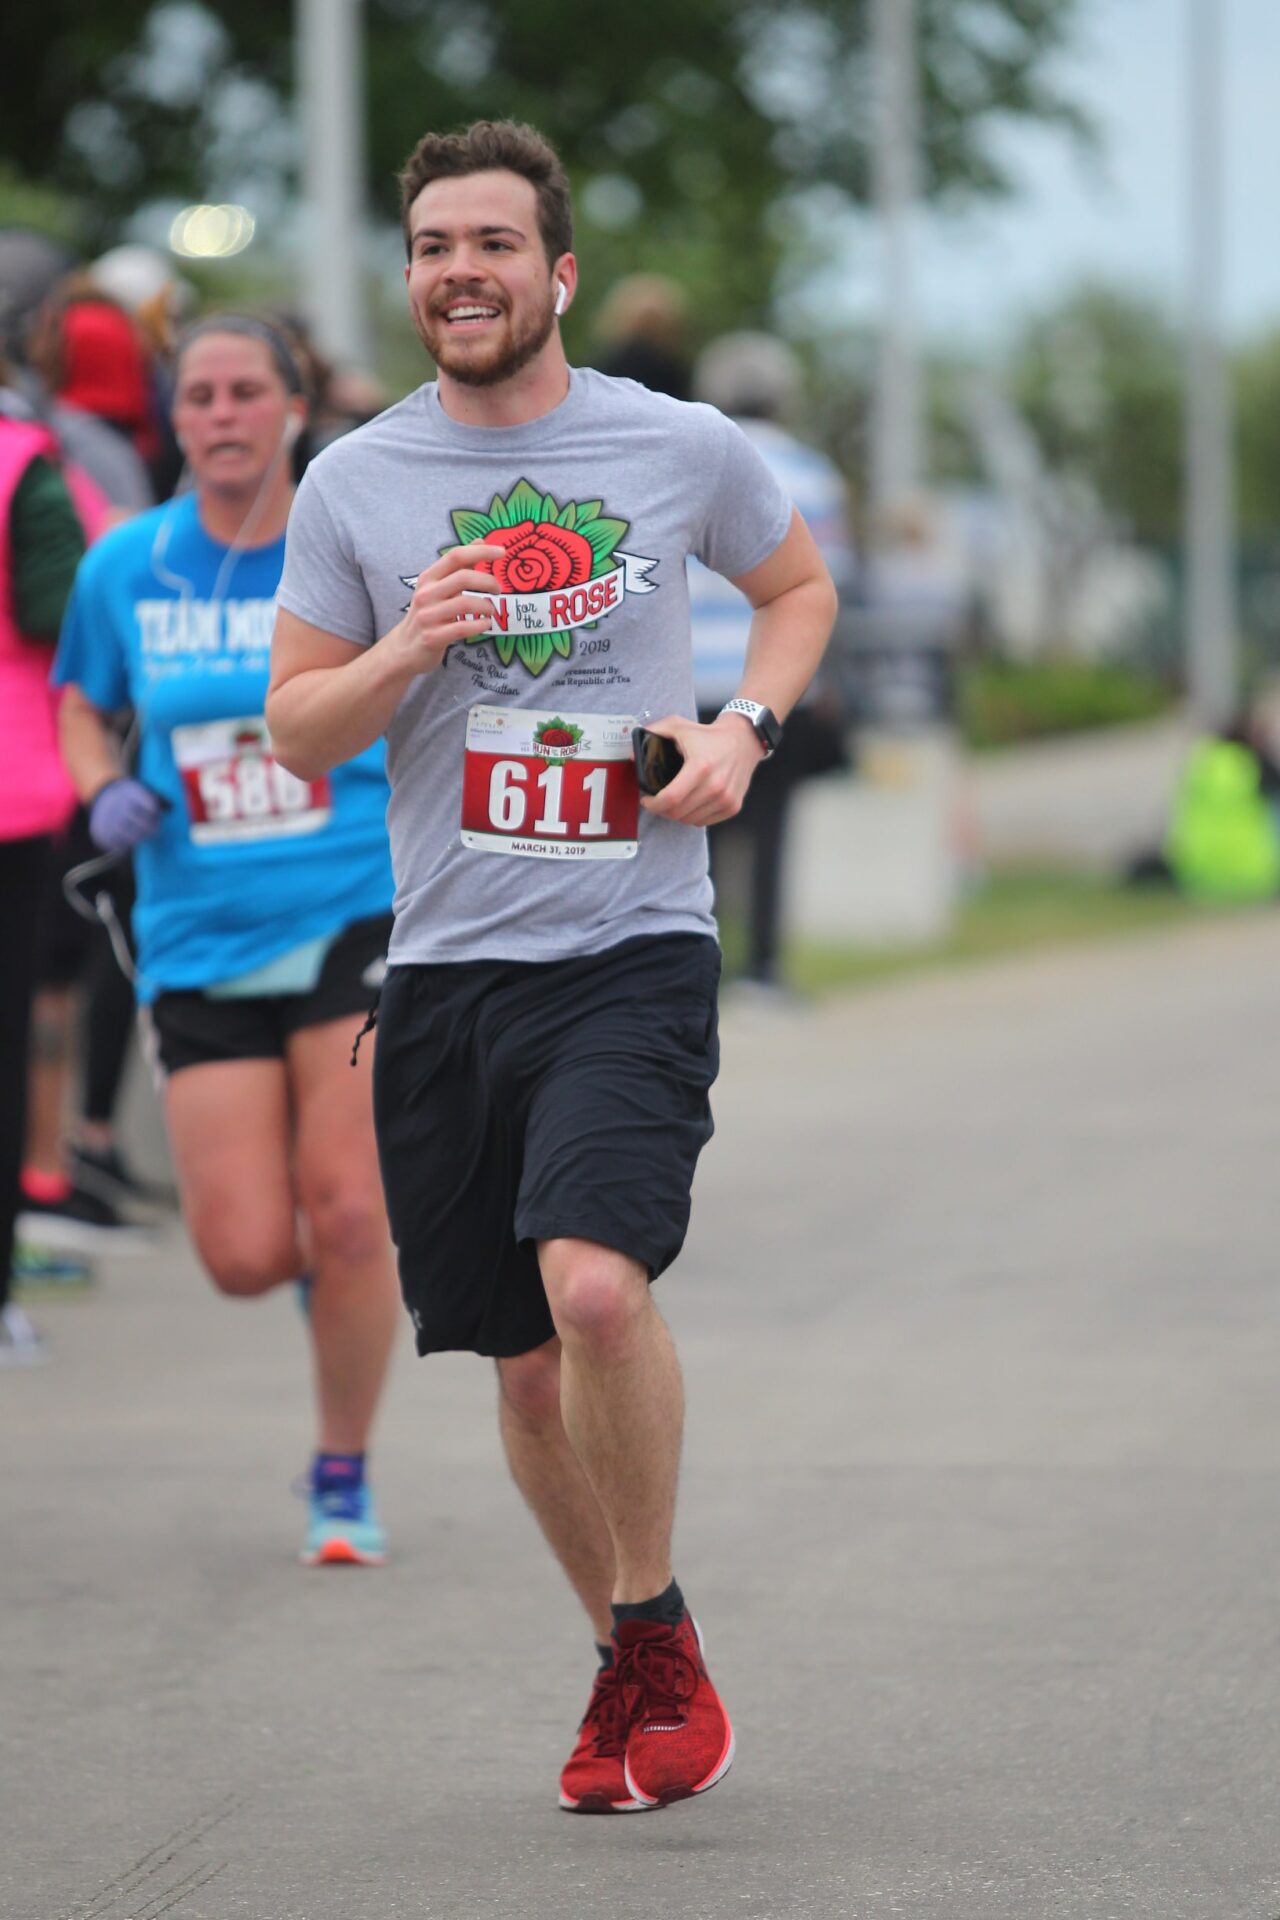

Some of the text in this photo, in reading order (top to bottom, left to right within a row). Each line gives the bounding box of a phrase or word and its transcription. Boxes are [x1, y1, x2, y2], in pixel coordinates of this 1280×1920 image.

[515, 598, 536, 620] for
[549, 575, 618, 627] ROSE
[135, 598, 223, 656] TEAM
[524, 617, 544, 629] the
[579, 639, 611, 656] 2019
[567, 676, 605, 687] Republic
[606, 677, 616, 685] of
[616, 675, 631, 684] Tea
[488, 760, 609, 836] 611
[511, 841, 586, 856] MARCH 31, 2019
